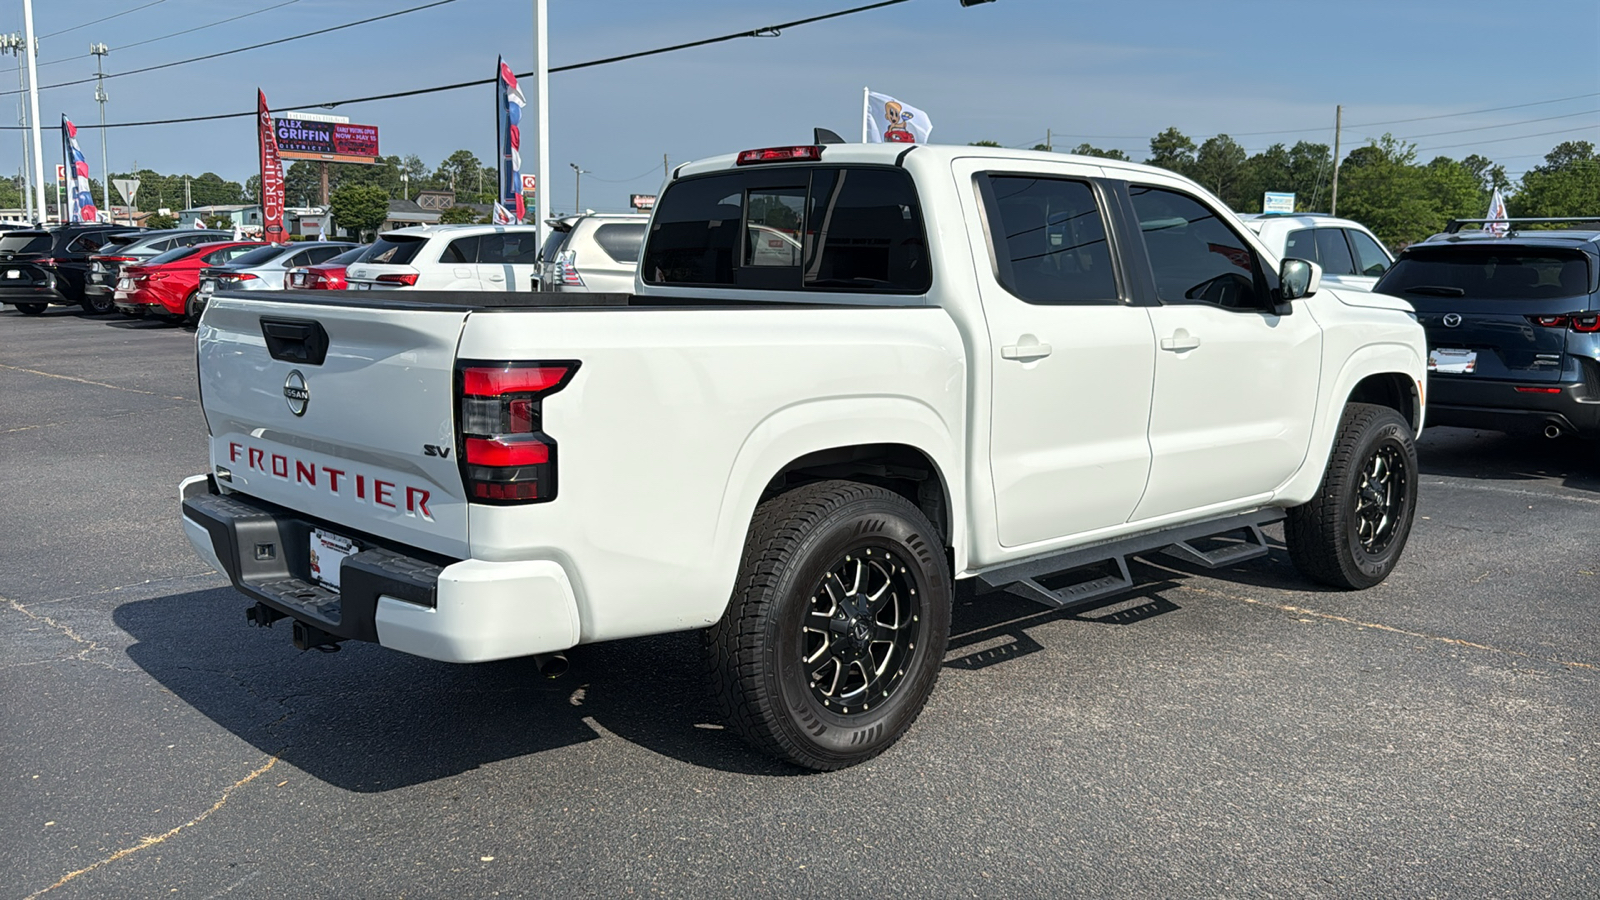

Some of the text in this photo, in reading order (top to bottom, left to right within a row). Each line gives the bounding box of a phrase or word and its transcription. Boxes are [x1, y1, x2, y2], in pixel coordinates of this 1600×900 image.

[278, 119, 302, 129] ALEX
[278, 127, 330, 142] GRIFFIN
[279, 143, 322, 151] DISTRICT
[265, 131, 277, 221] CERTIFIED
[423, 443, 451, 458] SV
[229, 442, 432, 519] FRONTIER
